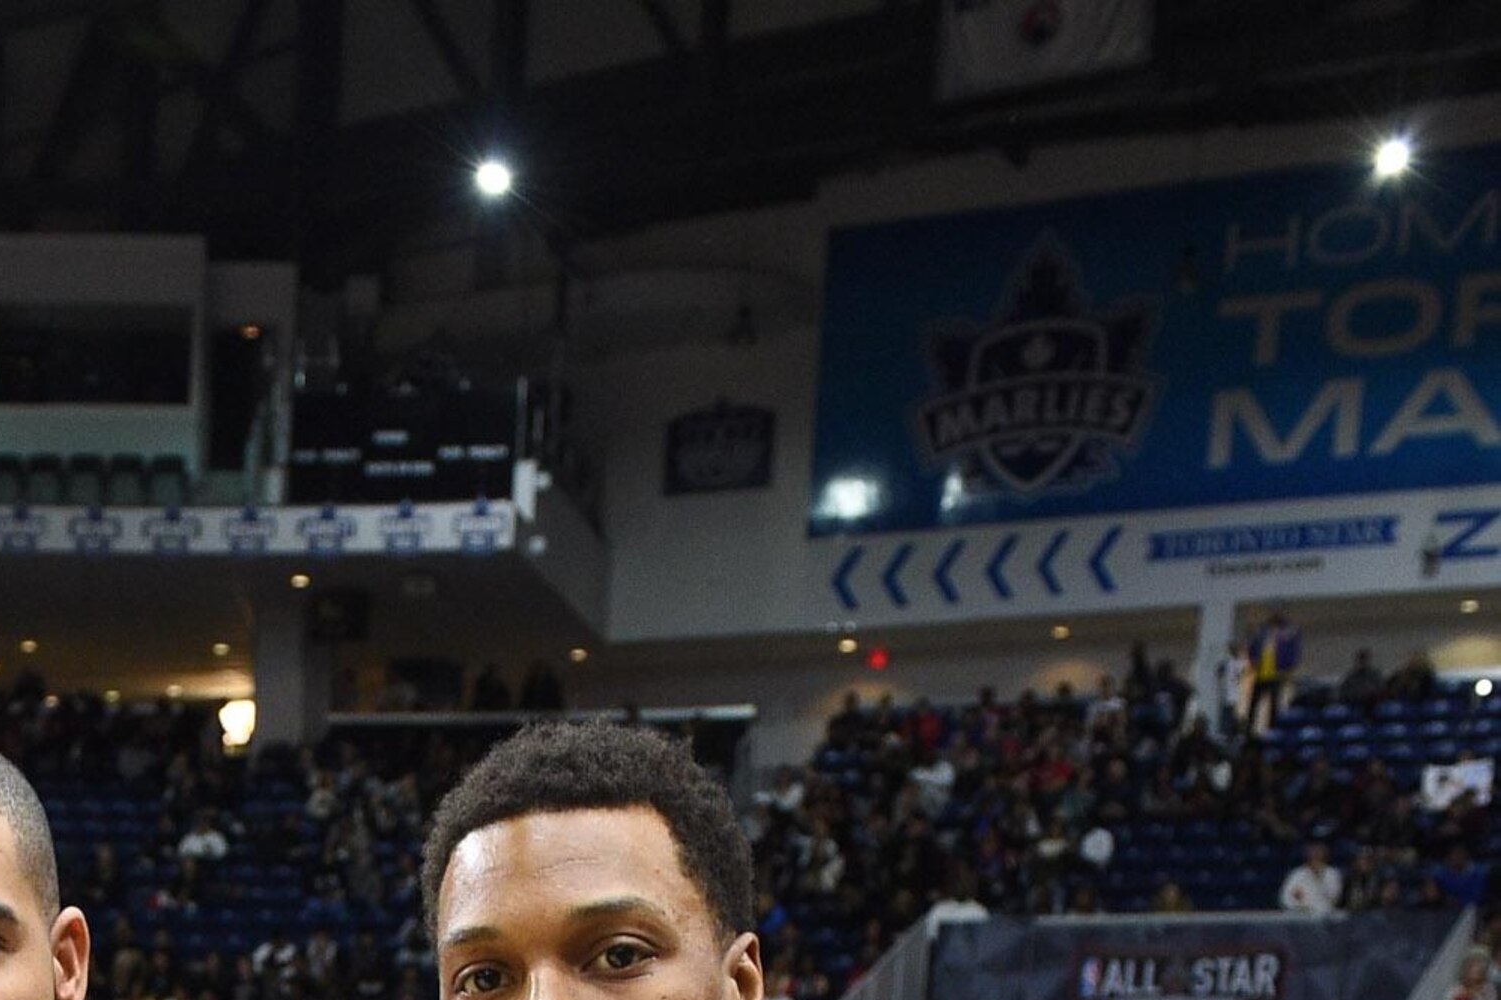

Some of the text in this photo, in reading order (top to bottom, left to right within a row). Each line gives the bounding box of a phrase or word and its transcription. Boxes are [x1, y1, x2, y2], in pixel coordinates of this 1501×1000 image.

[935, 382, 1133, 450] MARLIES
[1205, 366, 1501, 470] MA
[1102, 957, 1162, 998] ALL
[1191, 952, 1281, 1000] STAR
